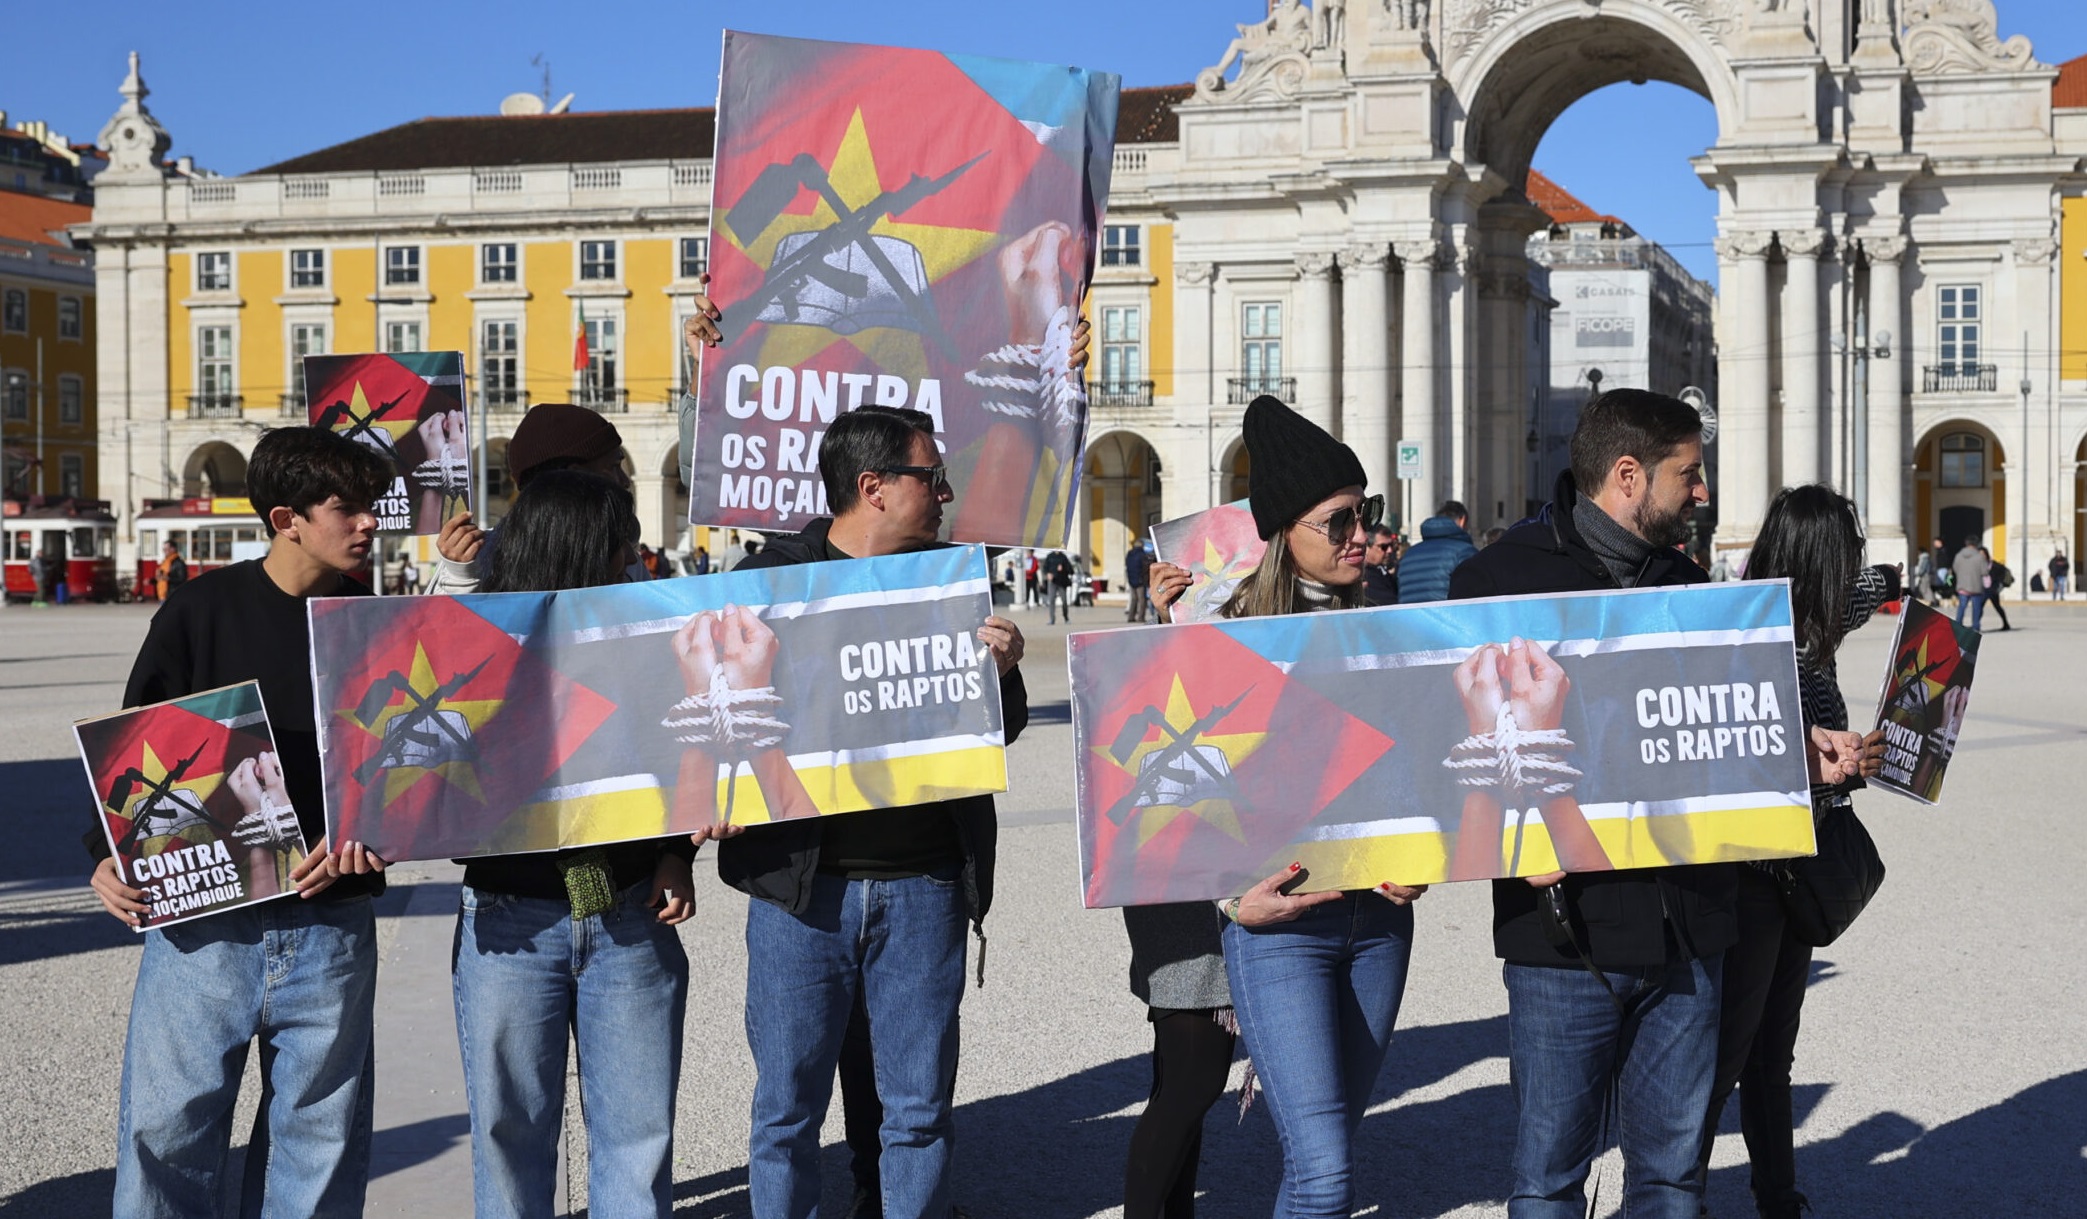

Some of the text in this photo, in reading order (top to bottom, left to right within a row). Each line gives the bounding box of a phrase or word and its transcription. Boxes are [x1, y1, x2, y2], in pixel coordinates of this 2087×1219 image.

[1577, 318, 1634, 333] FICOPE
[721, 433, 767, 470] OS
[840, 631, 977, 682] CONTRA
[844, 671, 982, 715] OS RAPTOS
[1635, 681, 1781, 729] CONTRA
[1640, 724, 1786, 764] OS RAPTOS
[1880, 763, 1912, 786] ÇAMBIQUE
[133, 840, 232, 882] CONTRA
[163, 863, 239, 897] RAPTOS
